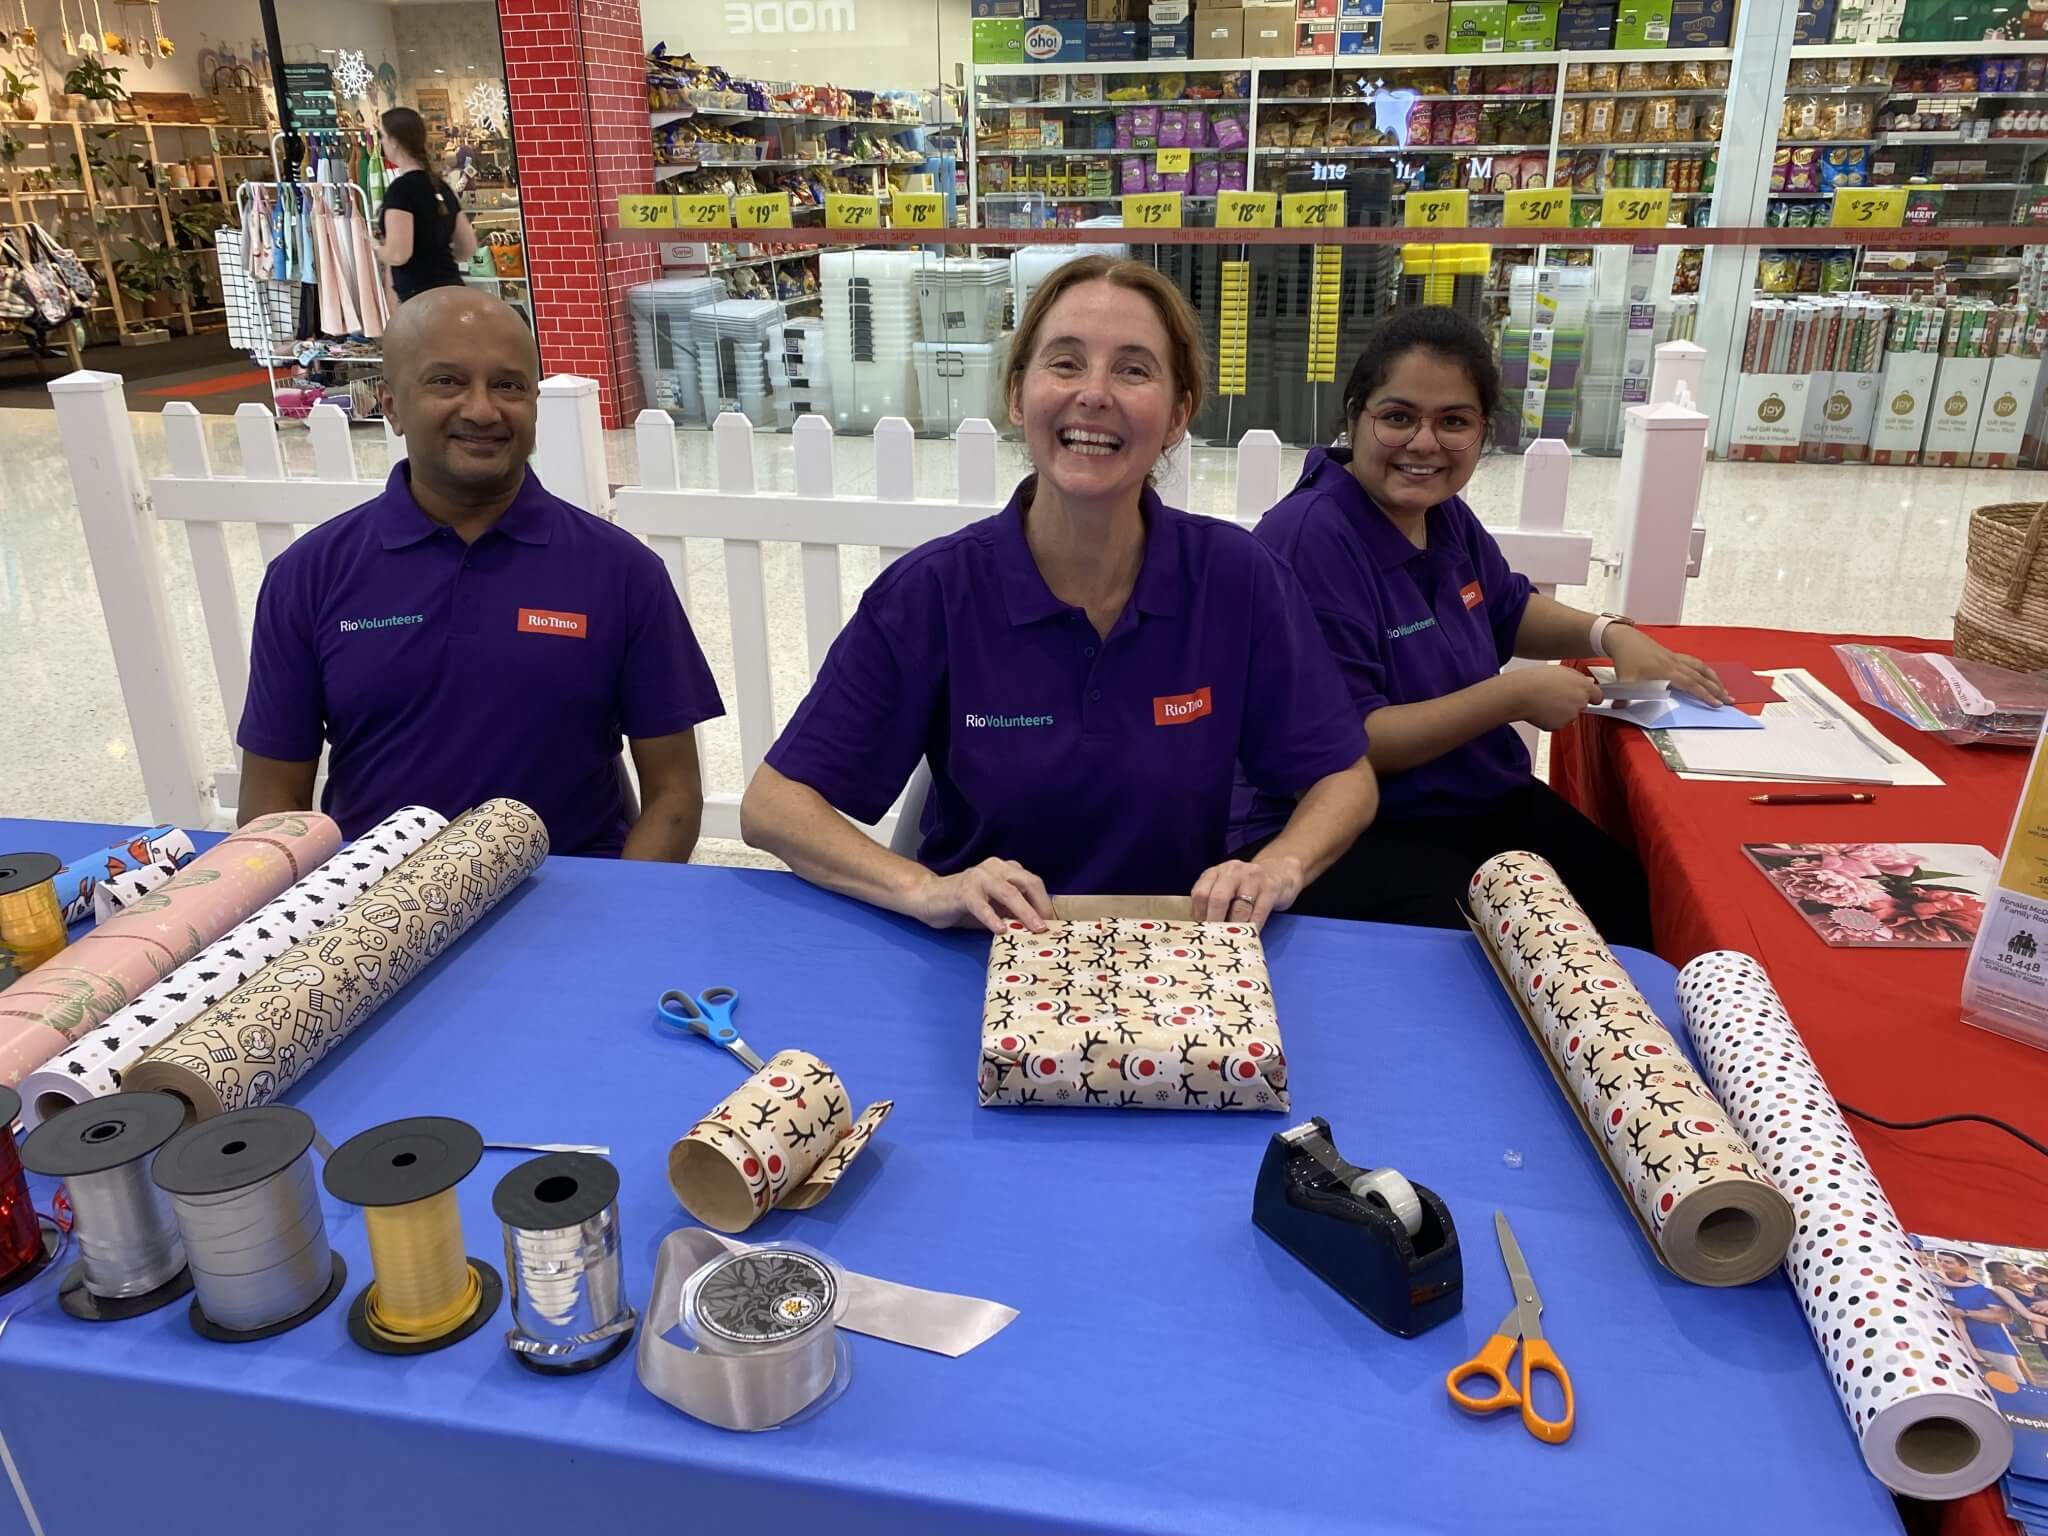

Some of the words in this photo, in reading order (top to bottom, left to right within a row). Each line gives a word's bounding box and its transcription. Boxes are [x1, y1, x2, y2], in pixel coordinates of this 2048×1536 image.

[1905, 210, 1938, 219] MERRY
[1761, 402, 1783, 418] joy
[1895, 400, 1912, 411] joy
[1948, 400, 1966, 411] joy
[1995, 400, 2015, 412] joy
[340, 614, 423, 632] RioVolunteers
[528, 615, 578, 630] RioTinto
[966, 714, 1054, 728] RioVolunteers
[2000, 896, 2027, 911] Ronald
[2004, 905, 2031, 920] Family
[1997, 953, 2041, 973] 18,448
